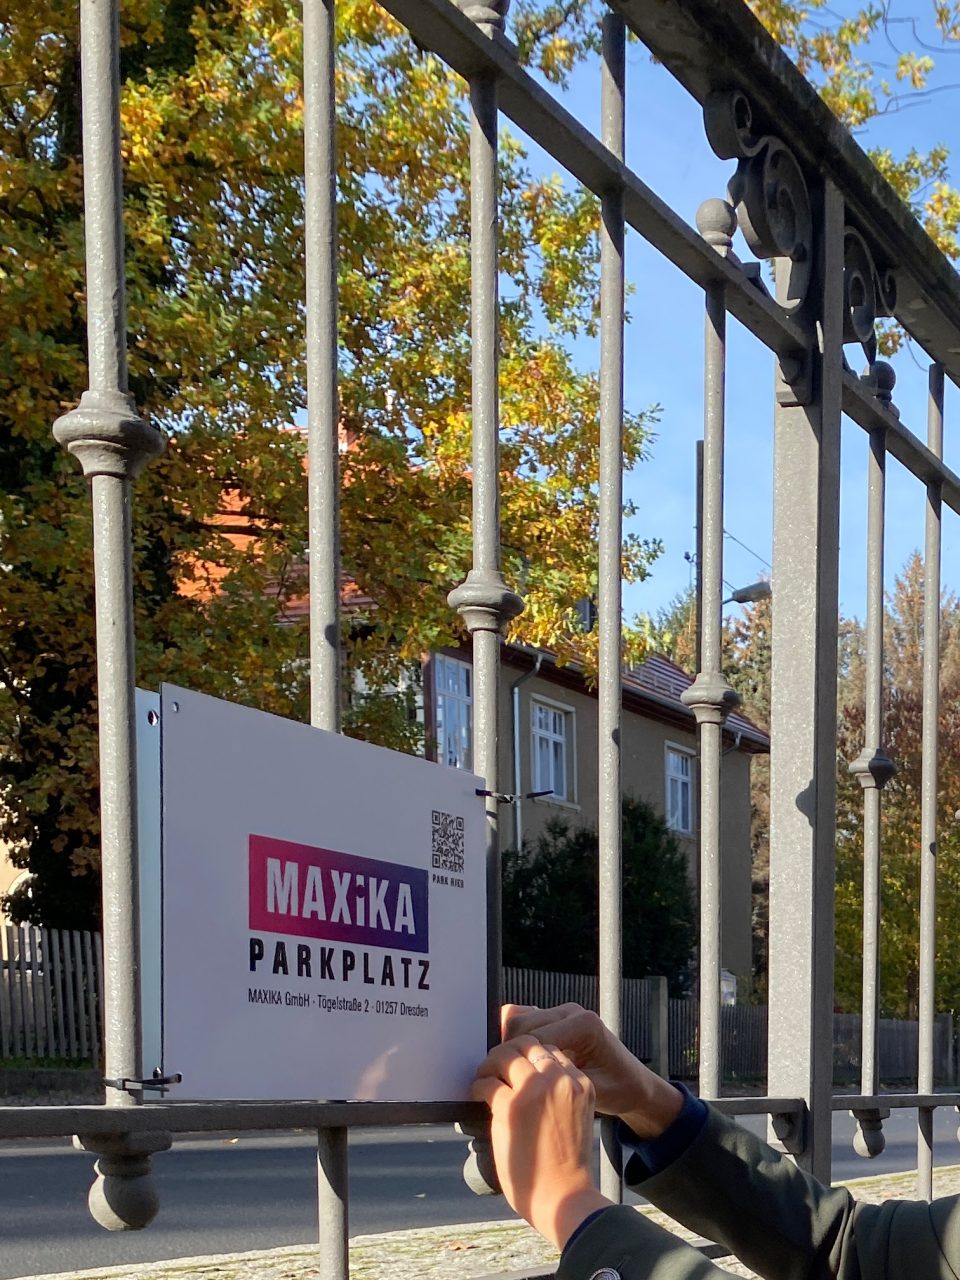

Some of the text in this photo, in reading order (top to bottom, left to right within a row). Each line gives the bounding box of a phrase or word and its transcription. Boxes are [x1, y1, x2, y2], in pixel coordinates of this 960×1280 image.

[432, 873, 449, 886] PARK
[249, 937, 430, 991] PARKPLATZ
[248, 987, 429, 1018] MAXIKA GmbH Tögelstraße 2 01257 Dresden
